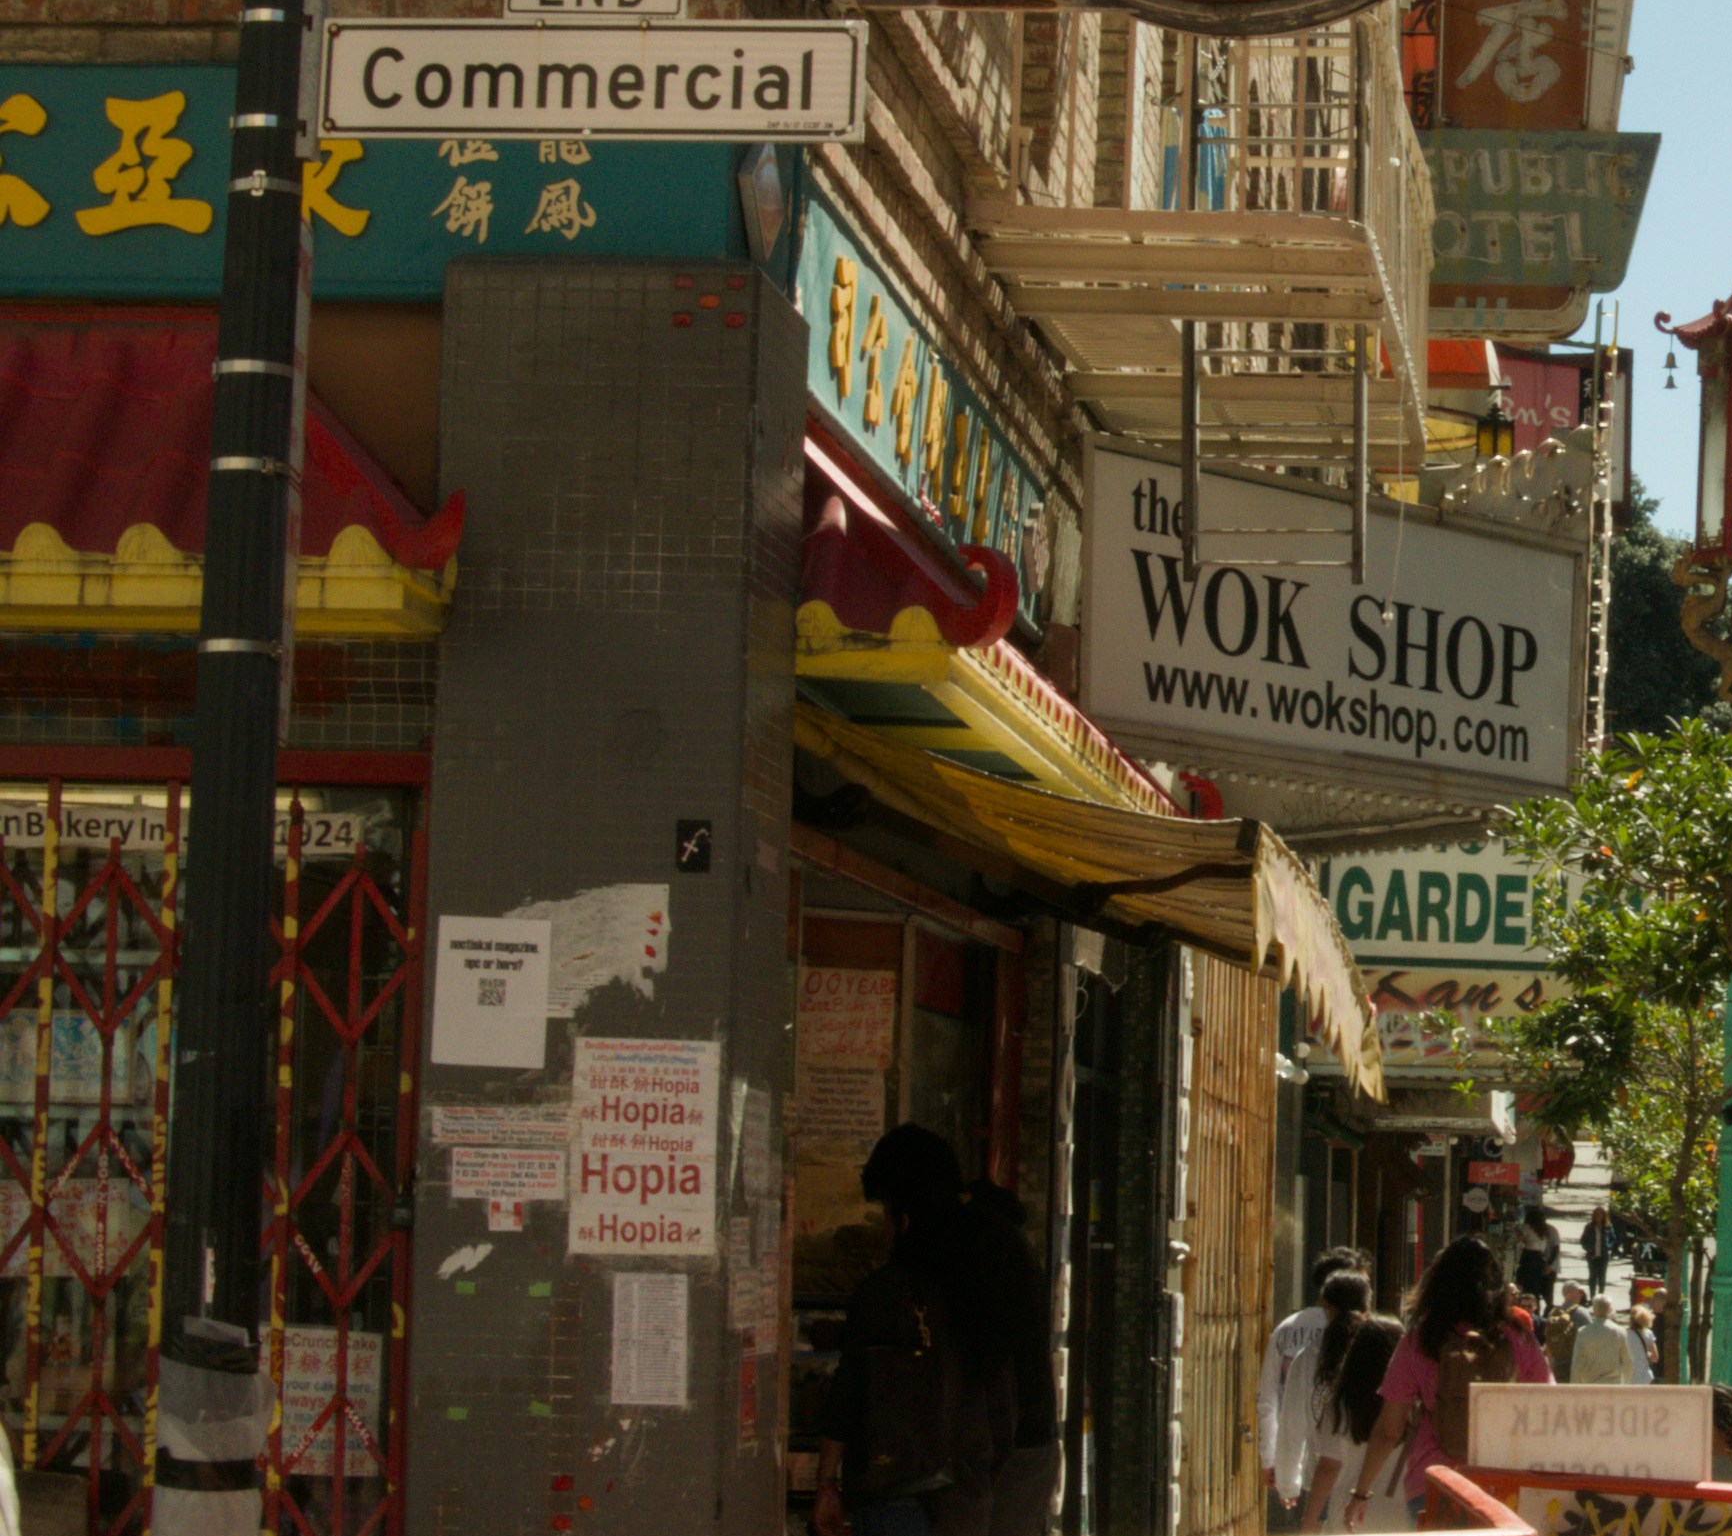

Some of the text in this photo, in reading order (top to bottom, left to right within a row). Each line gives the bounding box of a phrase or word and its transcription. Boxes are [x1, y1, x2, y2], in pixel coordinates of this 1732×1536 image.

[362, 47, 814, 111] Commercial
[1130, 478, 1187, 540] the
[1130, 548, 1540, 710] WOK SHOP
[651, 1077, 700, 1097] Hopia
[601, 1095, 685, 1131] Hopia
[649, 1135, 693, 1153] Hopia
[581, 1153, 701, 1205] Hopia
[599, 1214, 683, 1247] Hopia
